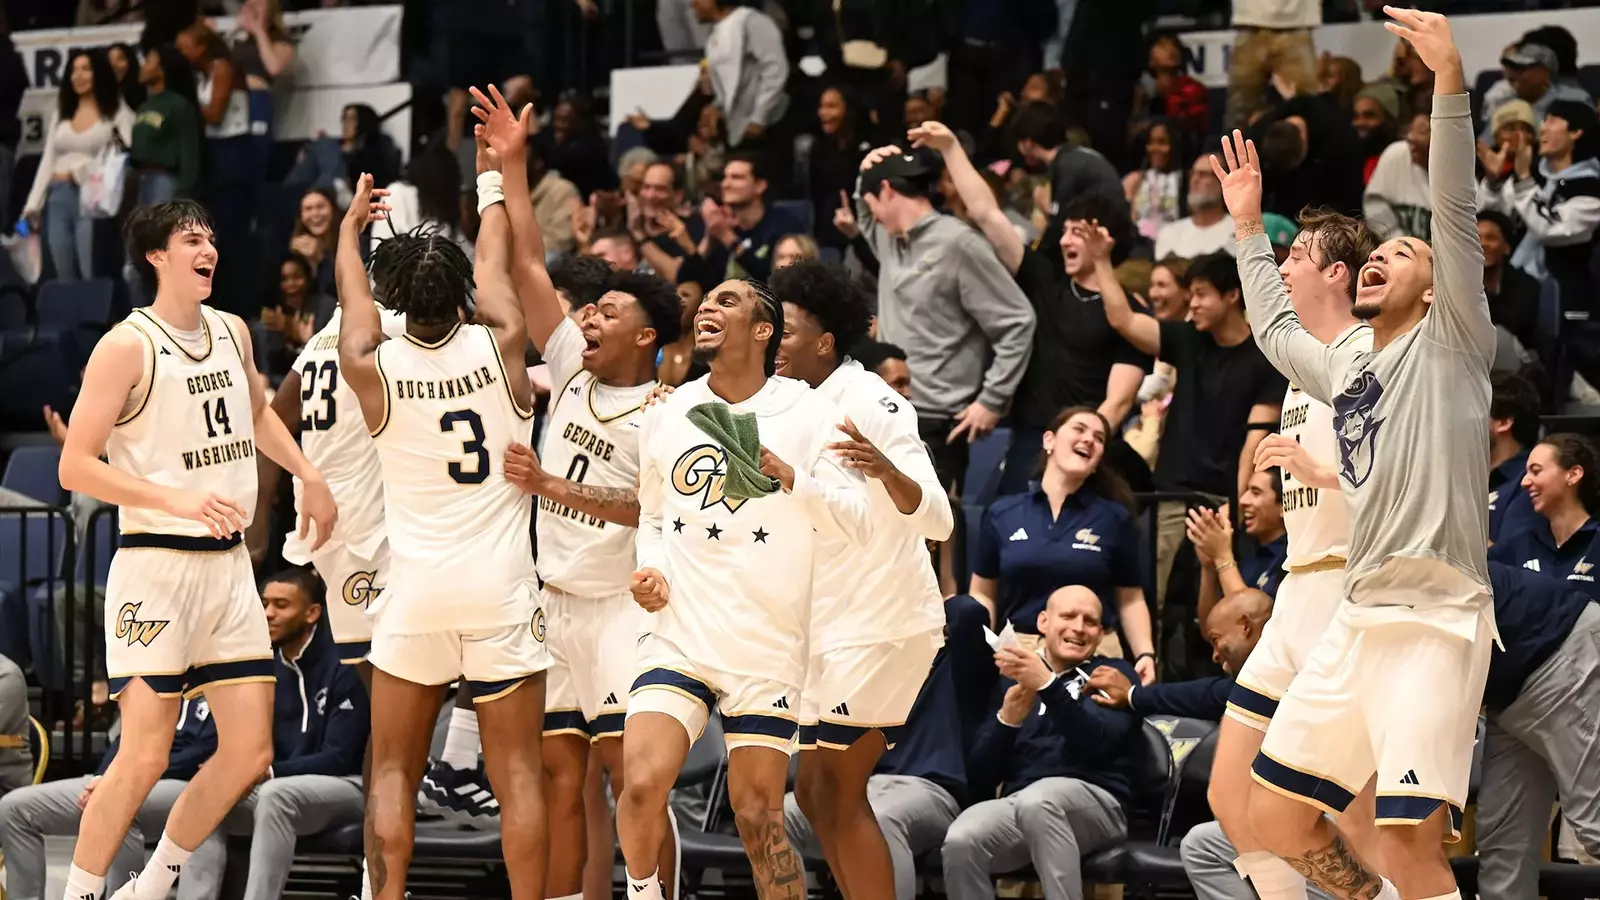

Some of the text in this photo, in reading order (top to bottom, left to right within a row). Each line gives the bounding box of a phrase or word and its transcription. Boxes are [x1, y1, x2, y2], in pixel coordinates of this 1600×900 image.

[187, 369, 233, 395] GEORGE
[300, 360, 338, 430] 23
[397, 366, 497, 399] BUCHANAN JR.
[203, 397, 232, 438] 14
[878, 396, 899, 414] 5
[439, 409, 490, 484] 3
[563, 421, 615, 462] GEORGE
[115, 600, 171, 647] GW
